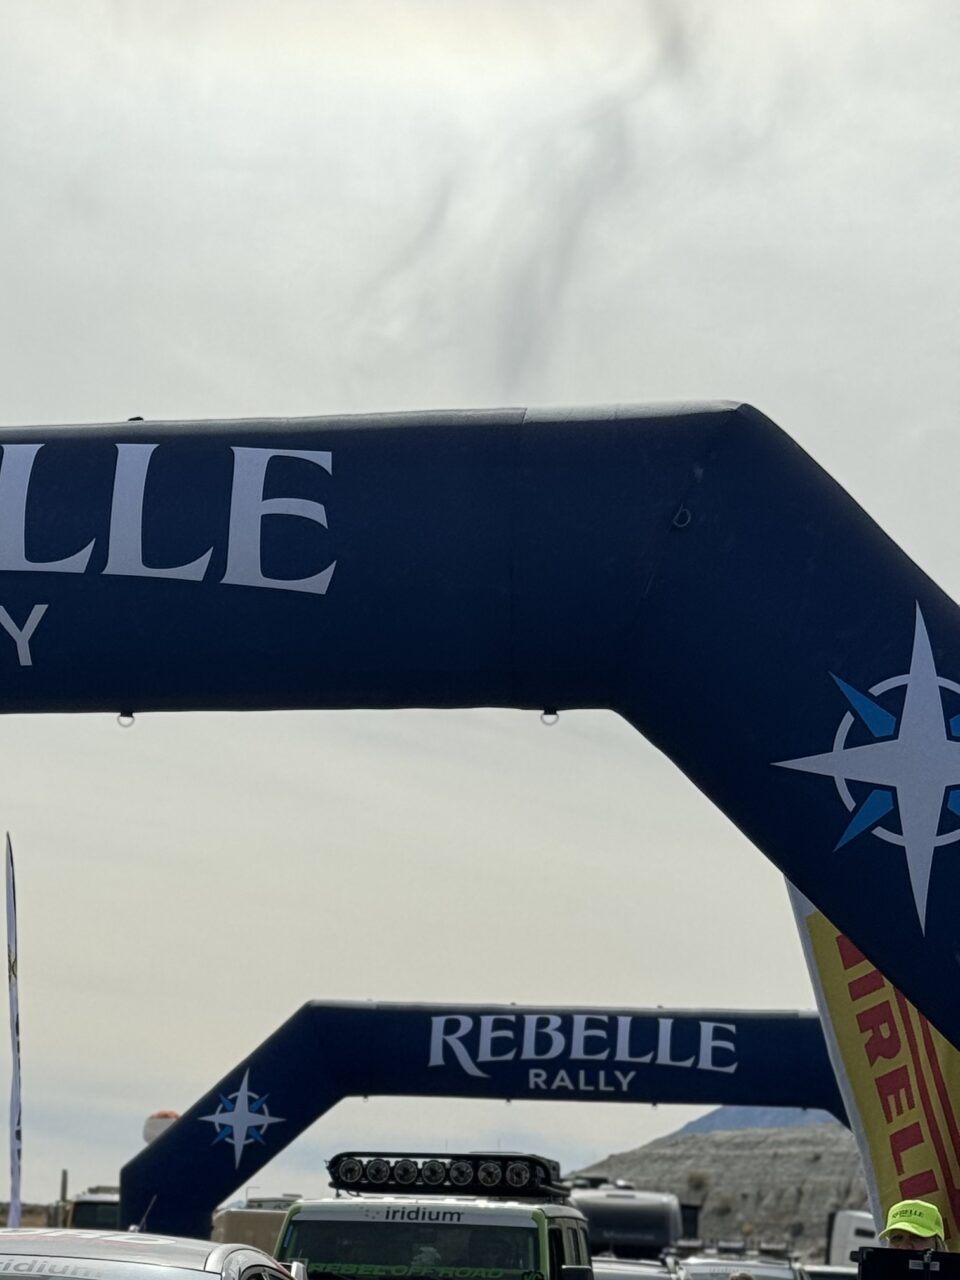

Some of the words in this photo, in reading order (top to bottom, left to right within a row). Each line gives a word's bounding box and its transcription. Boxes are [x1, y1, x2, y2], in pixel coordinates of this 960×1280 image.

[428, 1014, 738, 1078] REBELLE
[528, 1069, 636, 1092] RALLY
[384, 1206, 460, 1222] iridium
